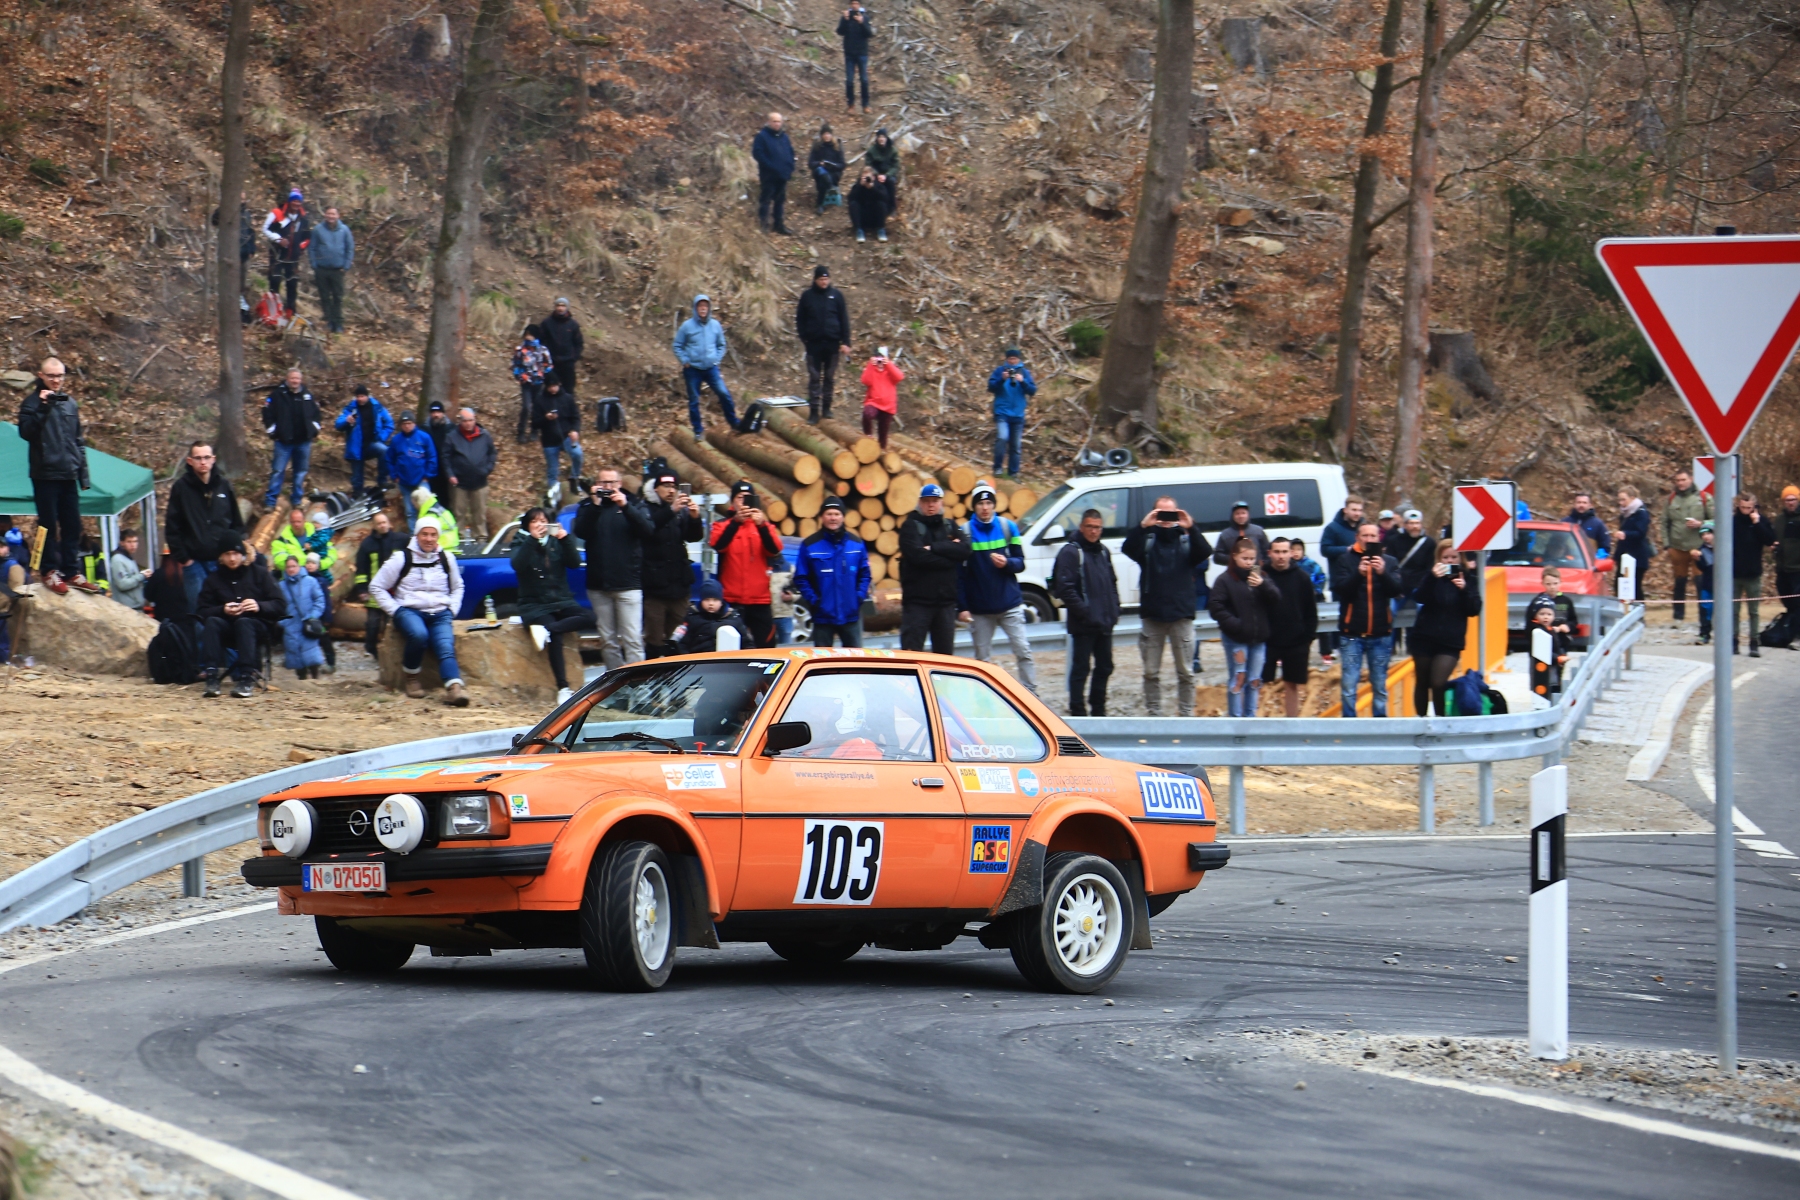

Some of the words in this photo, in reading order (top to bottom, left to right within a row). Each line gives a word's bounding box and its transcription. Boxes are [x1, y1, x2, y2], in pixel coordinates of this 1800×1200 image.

[1267, 495, 1287, 514] S5
[961, 744, 1016, 759] RECARO
[684, 768, 715, 780] celler
[794, 771, 875, 781] www.erzgebirgsrallye.de
[960, 768, 977, 777] ADAC
[684, 780, 717, 788] grundbau
[1038, 771, 1115, 788] Kraftwagenzentrum
[1145, 772, 1198, 810] DÜRR
[974, 827, 1010, 840] RALLYE
[803, 824, 882, 901] 103
[971, 863, 1007, 872] SUPERCUP
